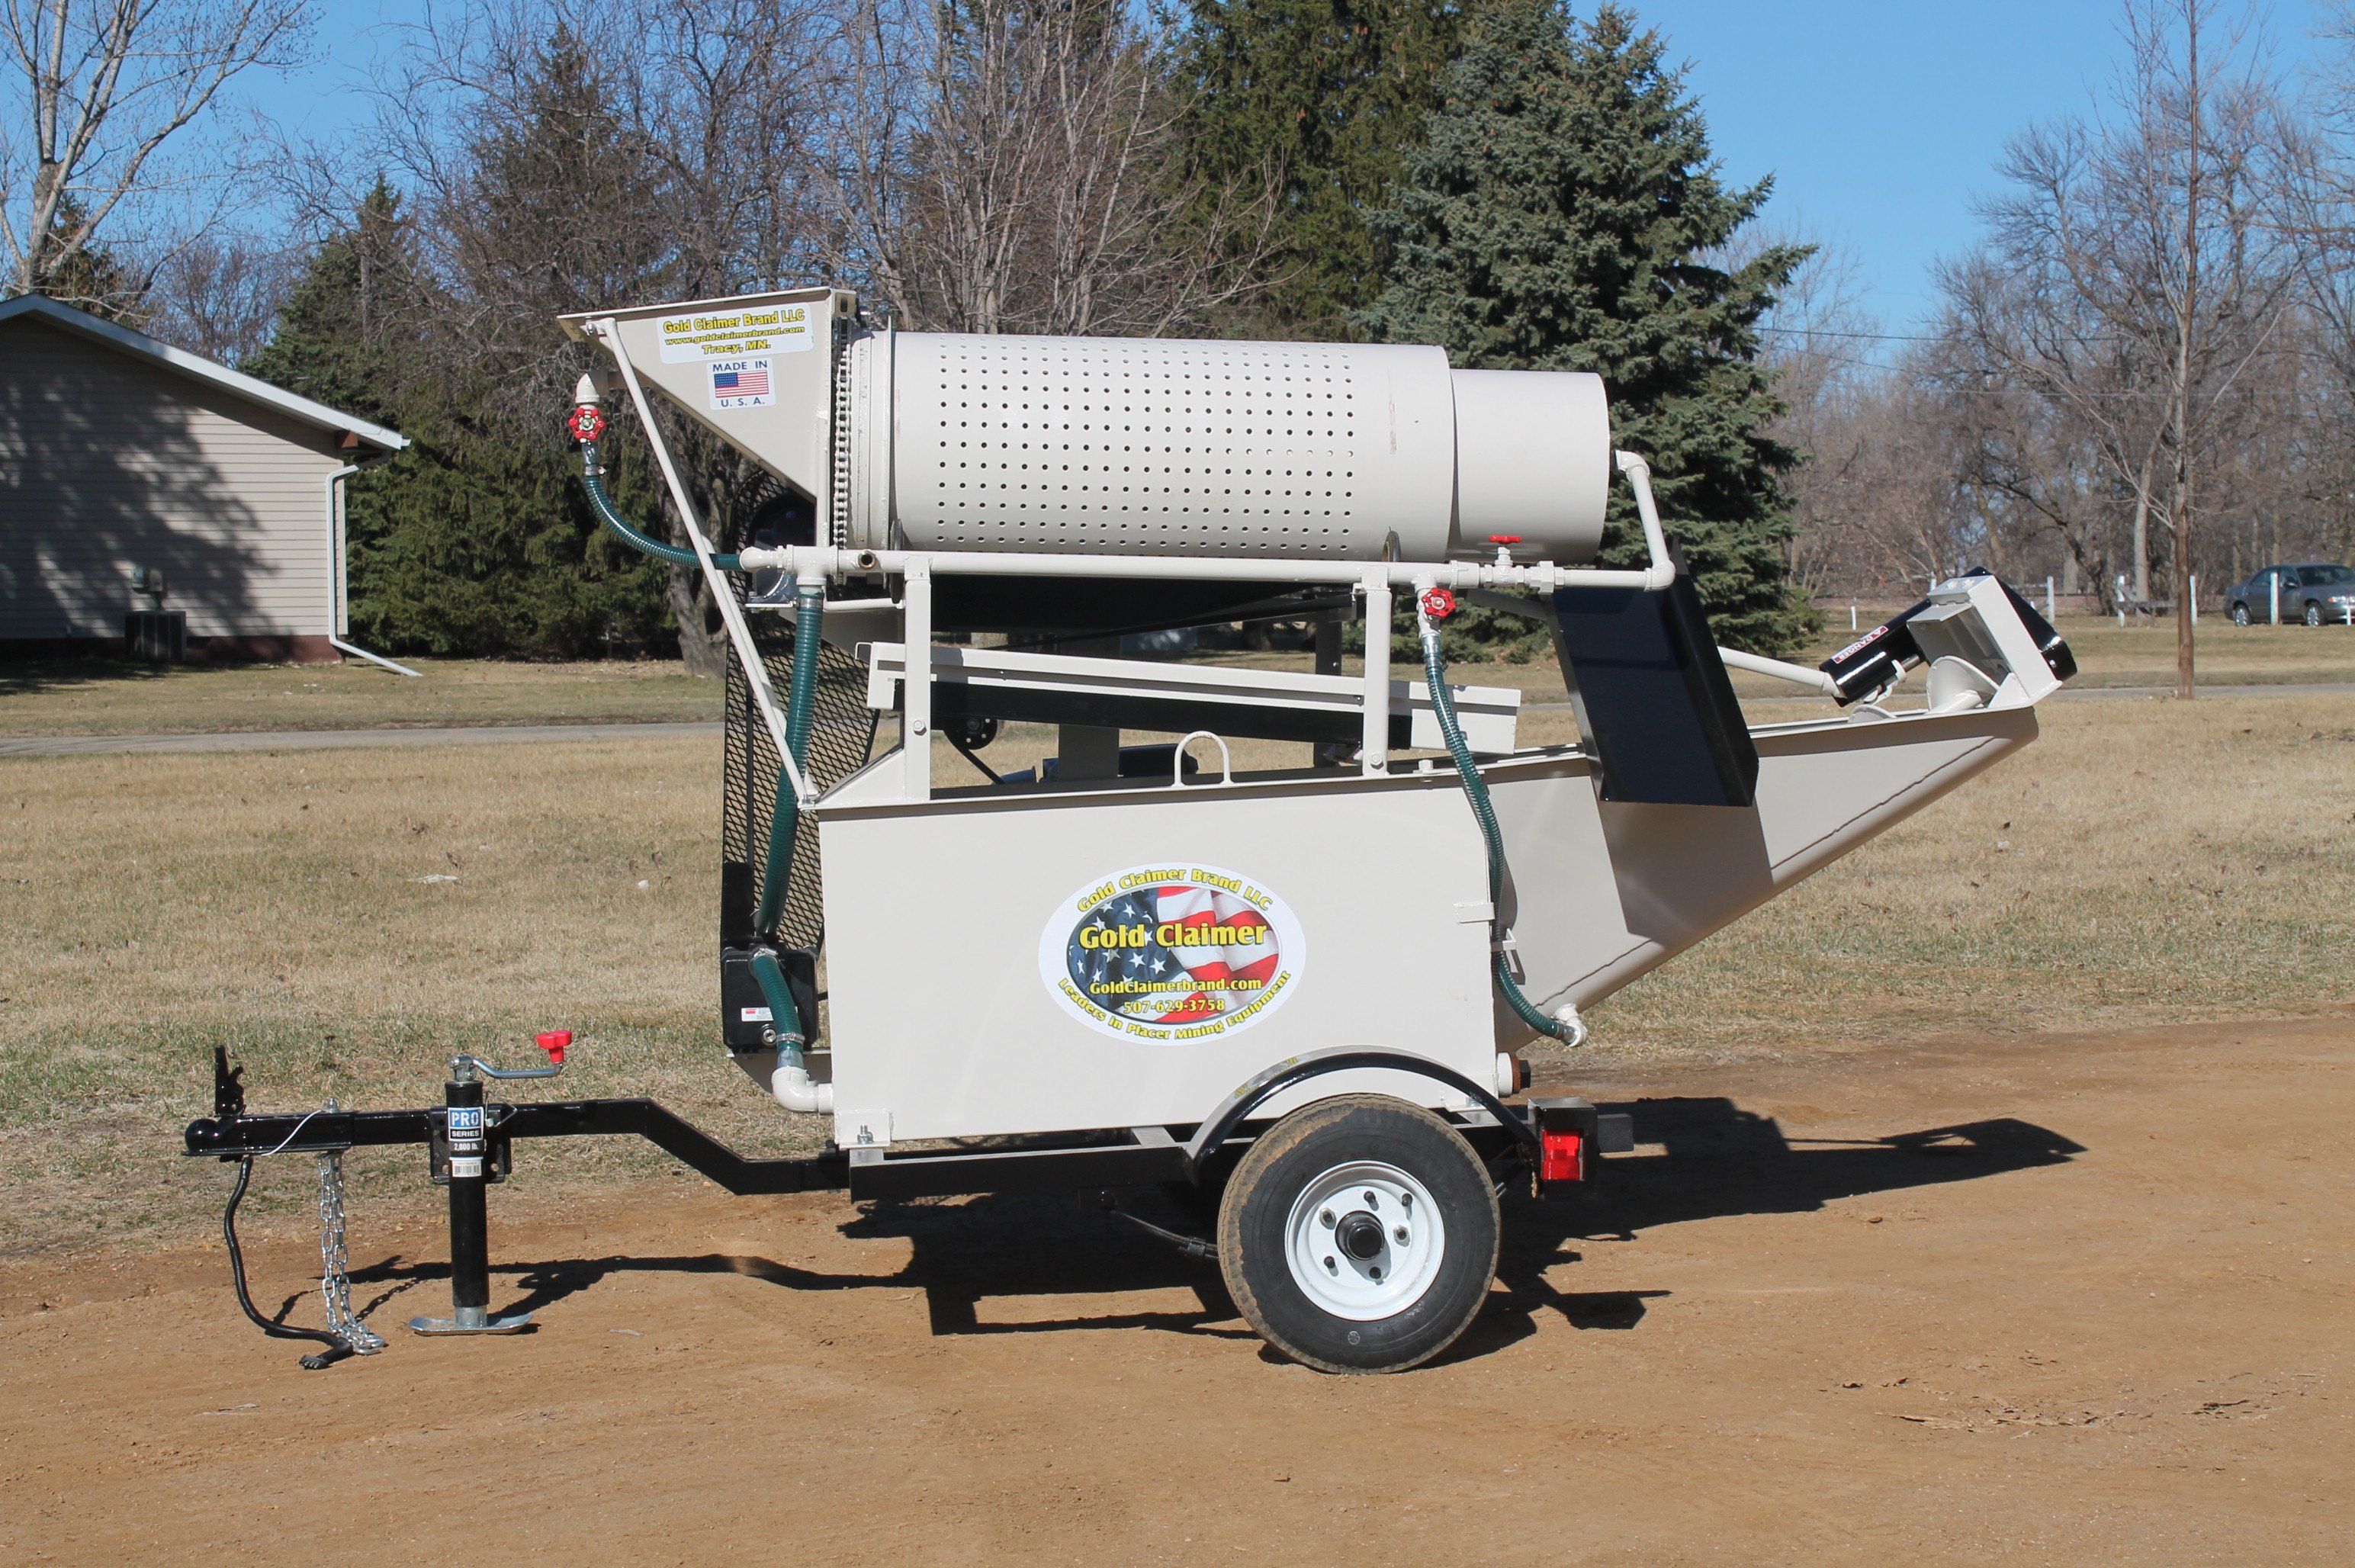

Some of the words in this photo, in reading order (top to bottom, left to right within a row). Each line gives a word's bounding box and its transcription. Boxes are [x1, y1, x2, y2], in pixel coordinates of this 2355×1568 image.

[663, 320, 692, 334] Gold
[694, 316, 741, 331] Claimer
[743, 311, 779, 326] Brand
[781, 309, 805, 323] LLC
[665, 326, 805, 345] www.goldclaimerbrand.com
[702, 342, 744, 355] Tracy,
[746, 339, 771, 350] MN.
[712, 361, 747, 371] MADE
[755, 360, 767, 368] IN
[1839, 635, 1874, 659] DANGER
[1077, 881, 1116, 912] Gold
[1119, 869, 1187, 889] Claimer
[1190, 868, 1242, 894] Brand
[1242, 885, 1274, 911] LLC
[1079, 924, 1145, 949] Gold
[1155, 922, 1267, 947] Claimer
[1089, 978, 1262, 994] GoldClaimerbrand.com
[1058, 978, 1107, 1021] Leaders
[1126, 1023, 1171, 1039] Placer
[1174, 1020, 1226, 1039] Mining
[1226, 970, 1291, 1027] Equipment
[1123, 998, 1226, 1014] 507-629-3758
[451, 1112, 479, 1126] PRO
[454, 1142, 471, 1151] 2,000
